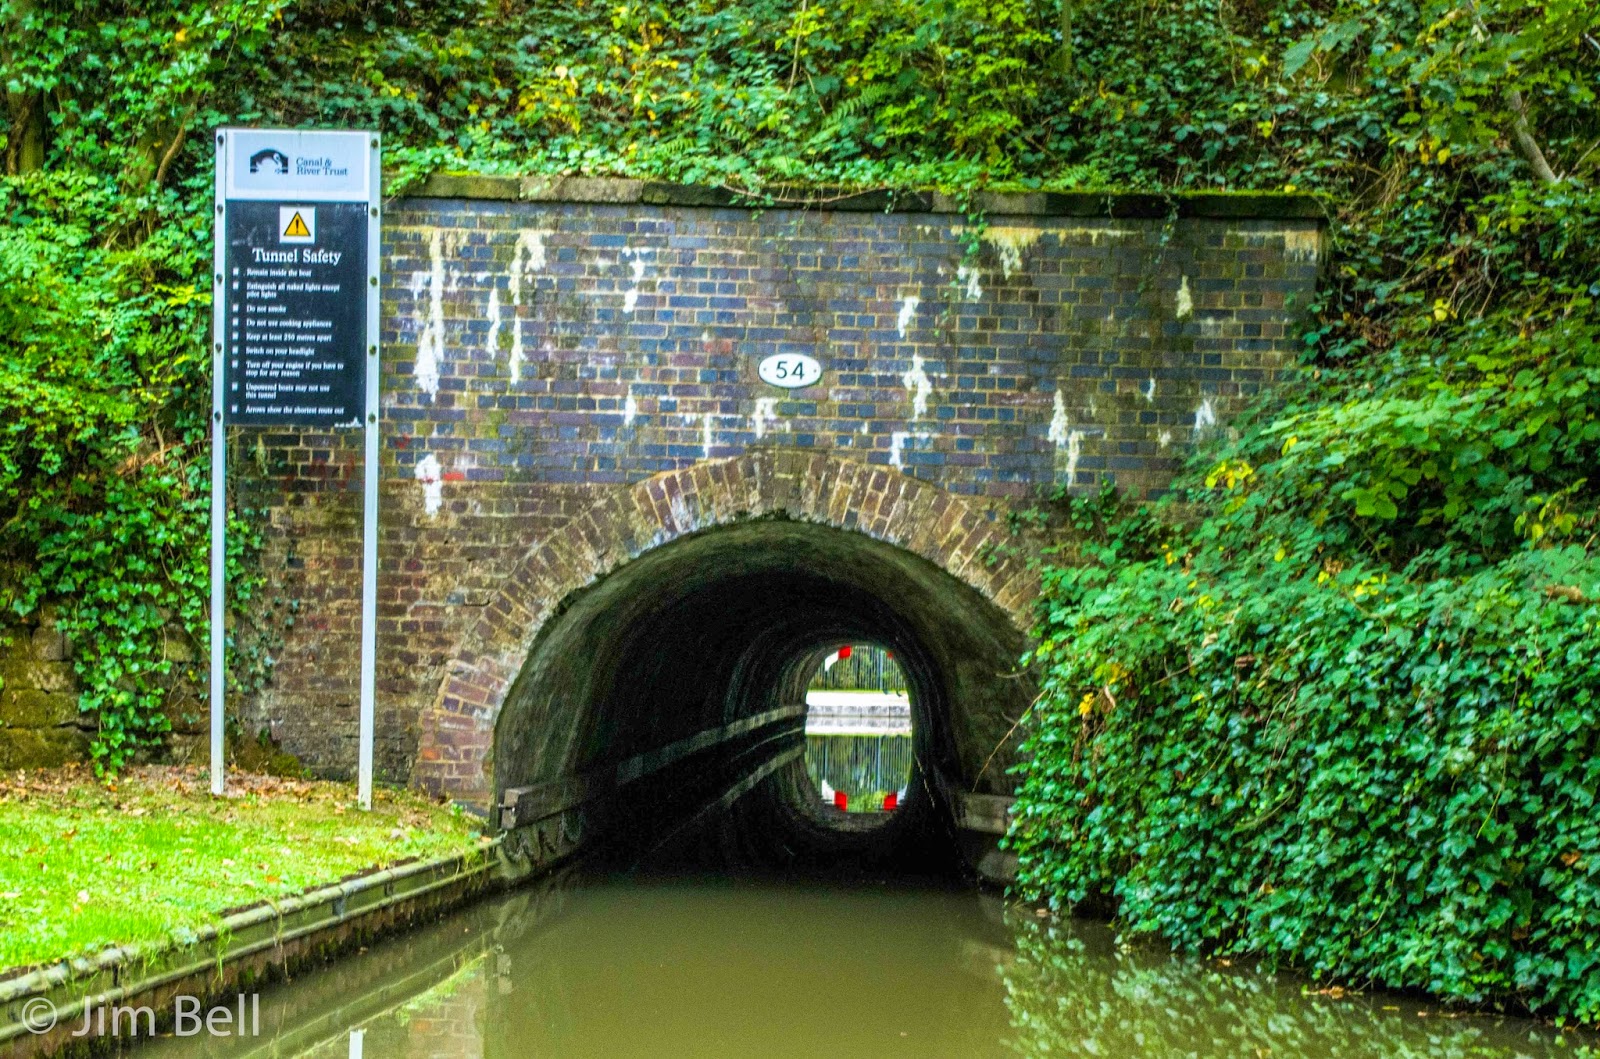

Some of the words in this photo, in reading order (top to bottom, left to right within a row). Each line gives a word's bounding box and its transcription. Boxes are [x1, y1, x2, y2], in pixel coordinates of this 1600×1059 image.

[296, 157, 322, 166] Canal
[325, 159, 332, 167] &
[296, 167, 320, 175] River
[323, 167, 348, 176] Trust
[252, 247, 297, 262] Tunnel
[303, 248, 342, 266] Safety
[247, 268, 268, 277] Remain
[270, 268, 287, 277] inside
[288, 269, 297, 277] the
[299, 269, 312, 277] boat
[247, 282, 276, 291] Extinguish
[287, 283, 304, 291] naked
[305, 284, 321, 293] lights
[322, 284, 340, 293] except
[247, 291, 260, 299] pilot
[261, 291, 277, 299] lights
[247, 305, 256, 313] Do
[268, 305, 287, 313] smoke
[247, 318, 256, 326] Do
[279, 319, 301, 328] cooking
[303, 319, 332, 328] appliances
[246, 332, 260, 341] Keep
[269, 333, 282, 341] least
[317, 334, 332, 342] apart
[246, 347, 264, 355] Switch
[275, 348, 288, 356] your
[289, 347, 315, 356] headlight
[246, 361, 260, 369] Turn
[262, 361, 270, 369] off
[271, 362, 284, 370] your
[286, 362, 304, 370] engine
[312, 363, 322, 371] you
[323, 362, 336, 370] have
[338, 362, 344, 370] to
[776, 361, 805, 380] 54
[260, 369, 268, 377] for
[269, 370, 279, 378] any
[246, 383, 277, 392] Unpowered
[278, 384, 294, 392] boats
[295, 385, 307, 393] may
[246, 405, 266, 414] Arrows
[267, 406, 282, 414] show
[283, 405, 292, 414] the
[294, 406, 317, 414] shortest
[334, 407, 344, 415] out
